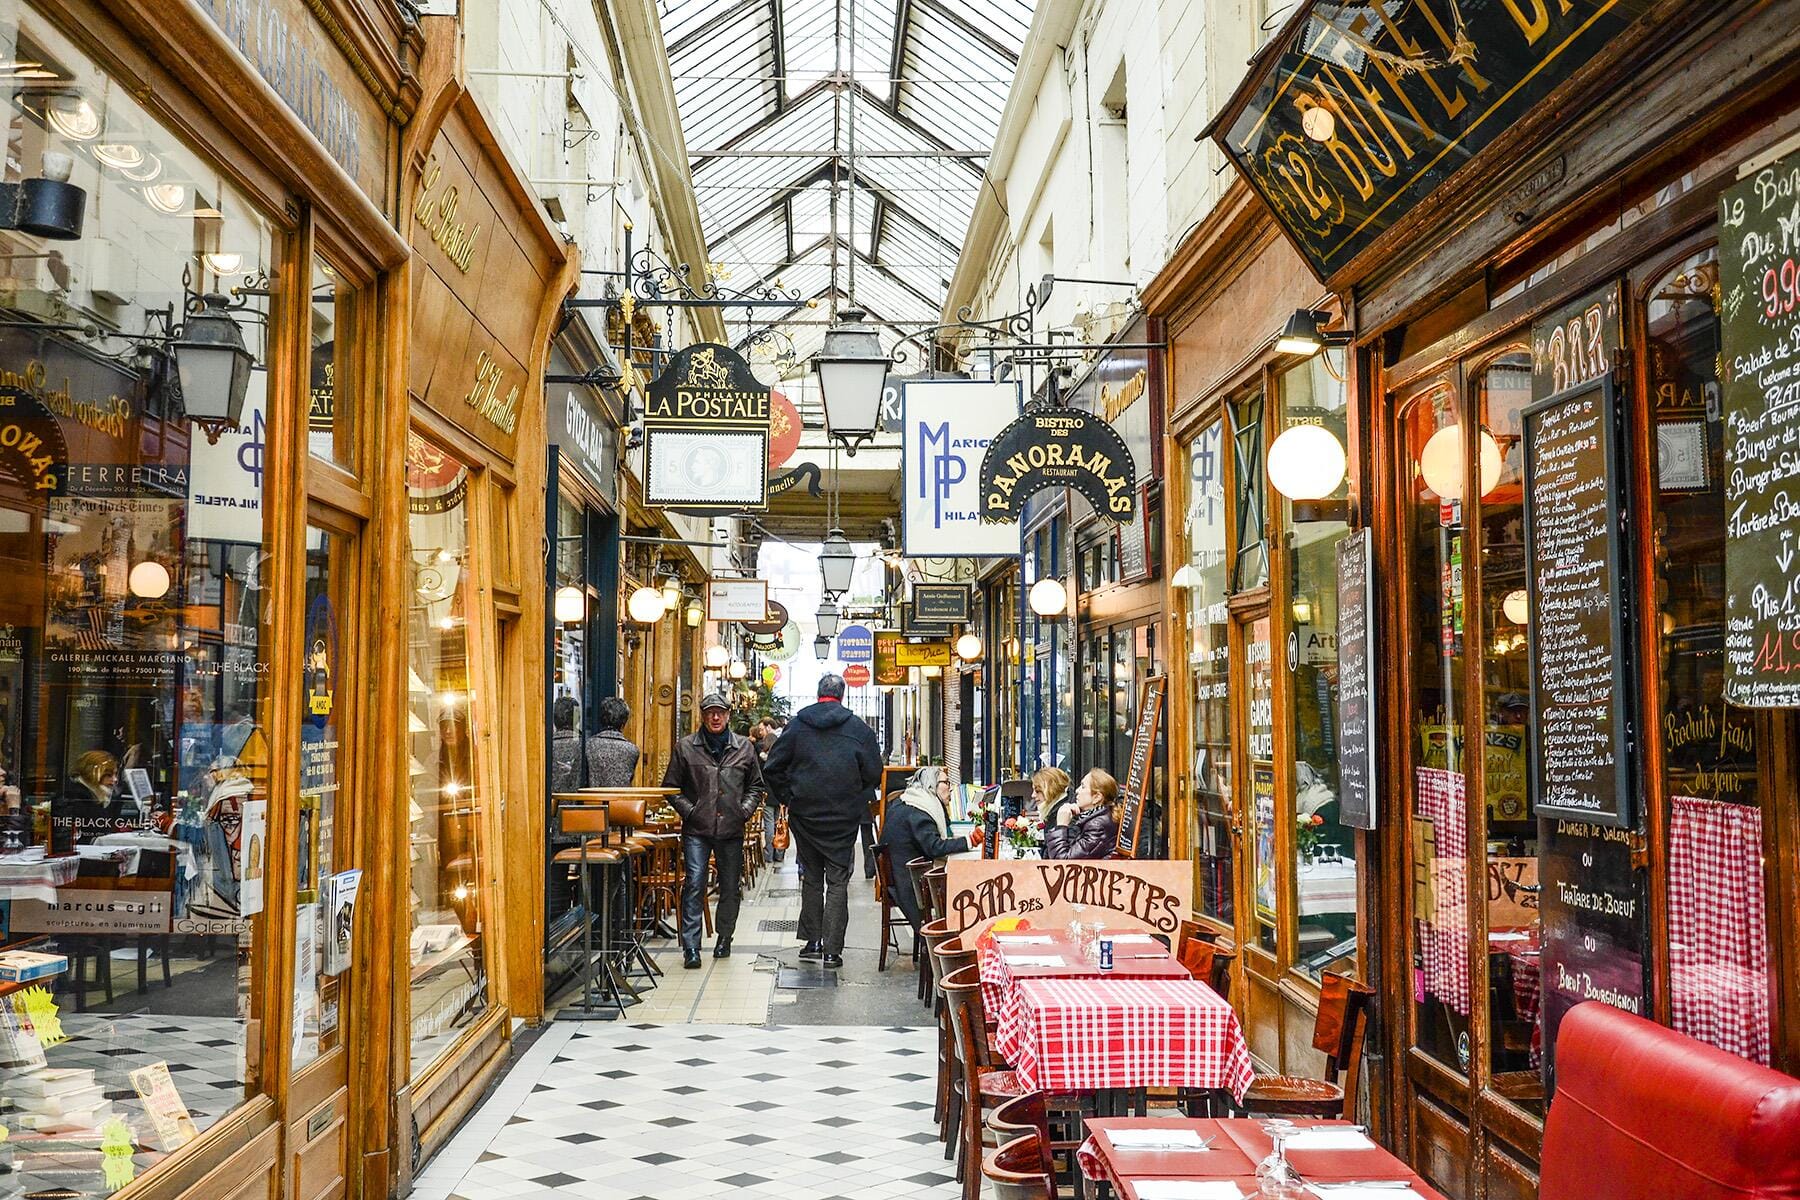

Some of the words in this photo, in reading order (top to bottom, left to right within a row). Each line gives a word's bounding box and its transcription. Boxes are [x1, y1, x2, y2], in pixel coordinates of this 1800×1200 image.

[1279, 151, 1332, 220] 12
[1722, 198, 1745, 228] Le
[1741, 232, 1775, 273] Du
[1548, 303, 1609, 395] BAR
[1735, 345, 1773, 382] Salade
[1775, 337, 1791, 360] de
[645, 391, 672, 416] LA
[677, 391, 768, 418] POSTALE
[566, 391, 590, 457] GYOZA
[590, 422, 603, 473] BAR
[1035, 417, 1083, 430] BISTRO
[1051, 429, 1069, 437] DES
[1735, 434, 1780, 464] Burger
[1783, 426, 1797, 445] de
[68, 466, 187, 484] FERREIRA
[988, 443, 1132, 513] PANORAMAS
[1042, 468, 1078, 477] RESTAURANT
[1731, 467, 1771, 500] Burger
[1771, 461, 1784, 482] de
[1731, 500, 1768, 539] Tartare
[1752, 583, 1780, 622] Plus
[51, 653, 90, 662] GALERIE
[94, 654, 135, 663] MICKAEL
[139, 654, 192, 664] MARCIANO
[113, 666, 130, 674] Rivoli
[136, 666, 156, 674] 75001
[158, 667, 174, 675] Paris
[211, 661, 230, 672] THE
[234, 661, 269, 673] BLACK
[1664, 704, 1715, 752] Produits
[1721, 704, 1752, 758] frais
[53, 816, 72, 828] THE
[75, 817, 112, 829] BLACK
[115, 817, 163, 829] GALLERY
[1591, 824, 1600, 838] DE
[1582, 852, 1592, 867] OU
[48, 900, 115, 912] marcus
[952, 871, 1017, 932] BAR
[1018, 897, 1044, 915] DES
[1037, 864, 1181, 933] VARIETES
[1557, 880, 1591, 909] TARTARE
[1592, 892, 1603, 912] DE
[46, 919, 94, 929] sculptures
[98, 919, 109, 928] en
[114, 919, 161, 930] aluminium
[1584, 935, 1596, 952] OU
[1582, 972, 1638, 1014] BOURGUIGNON
